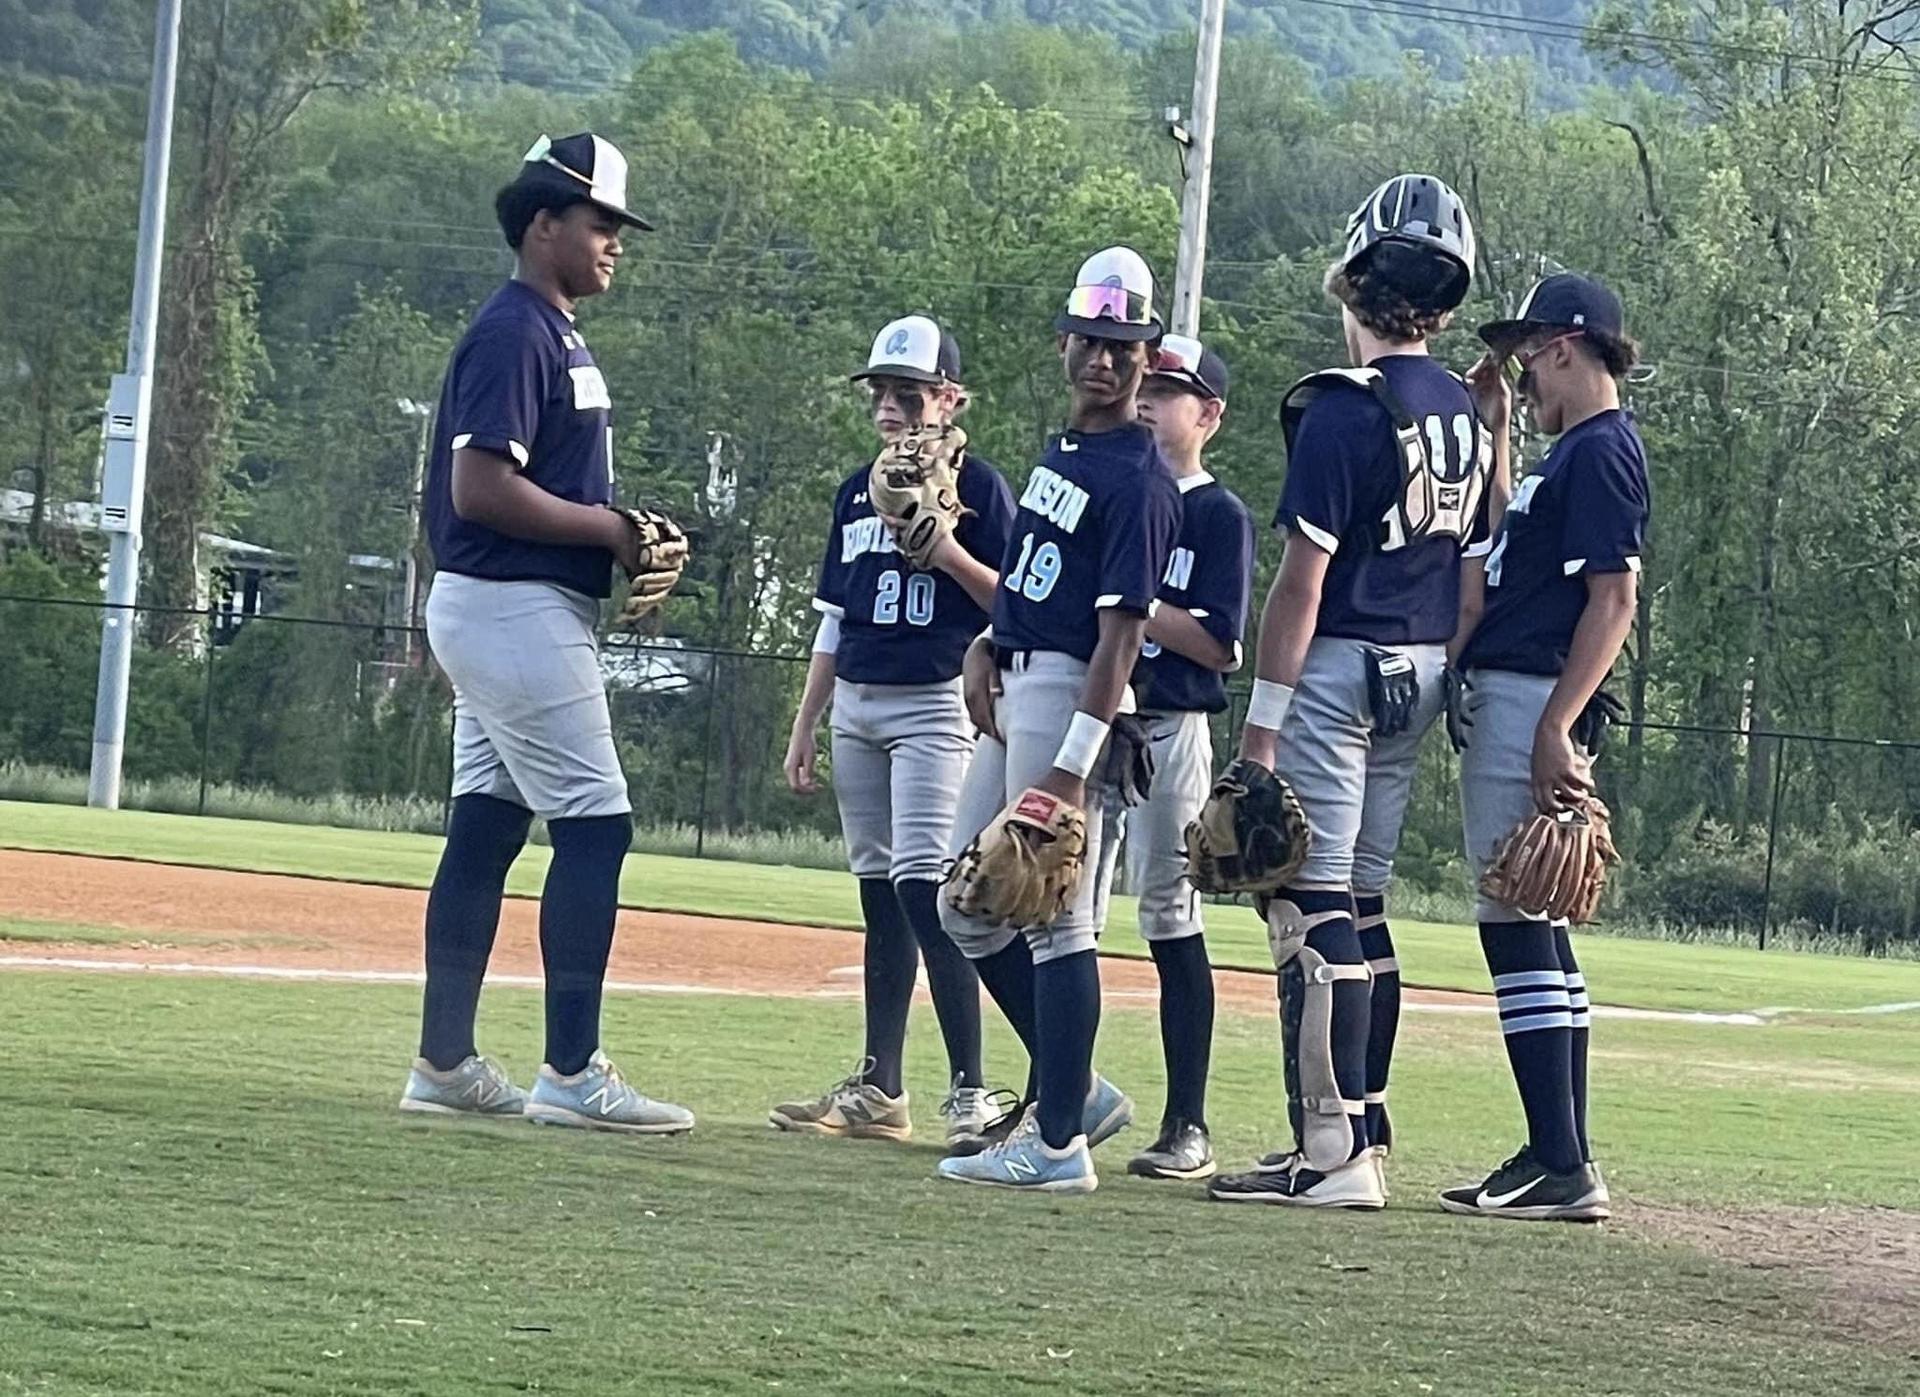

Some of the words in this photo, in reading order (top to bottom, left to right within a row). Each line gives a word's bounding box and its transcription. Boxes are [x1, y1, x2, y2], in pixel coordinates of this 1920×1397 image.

[1004, 532, 1062, 602] 19
[873, 570, 935, 626] 20
[583, 1087, 625, 1115] N
